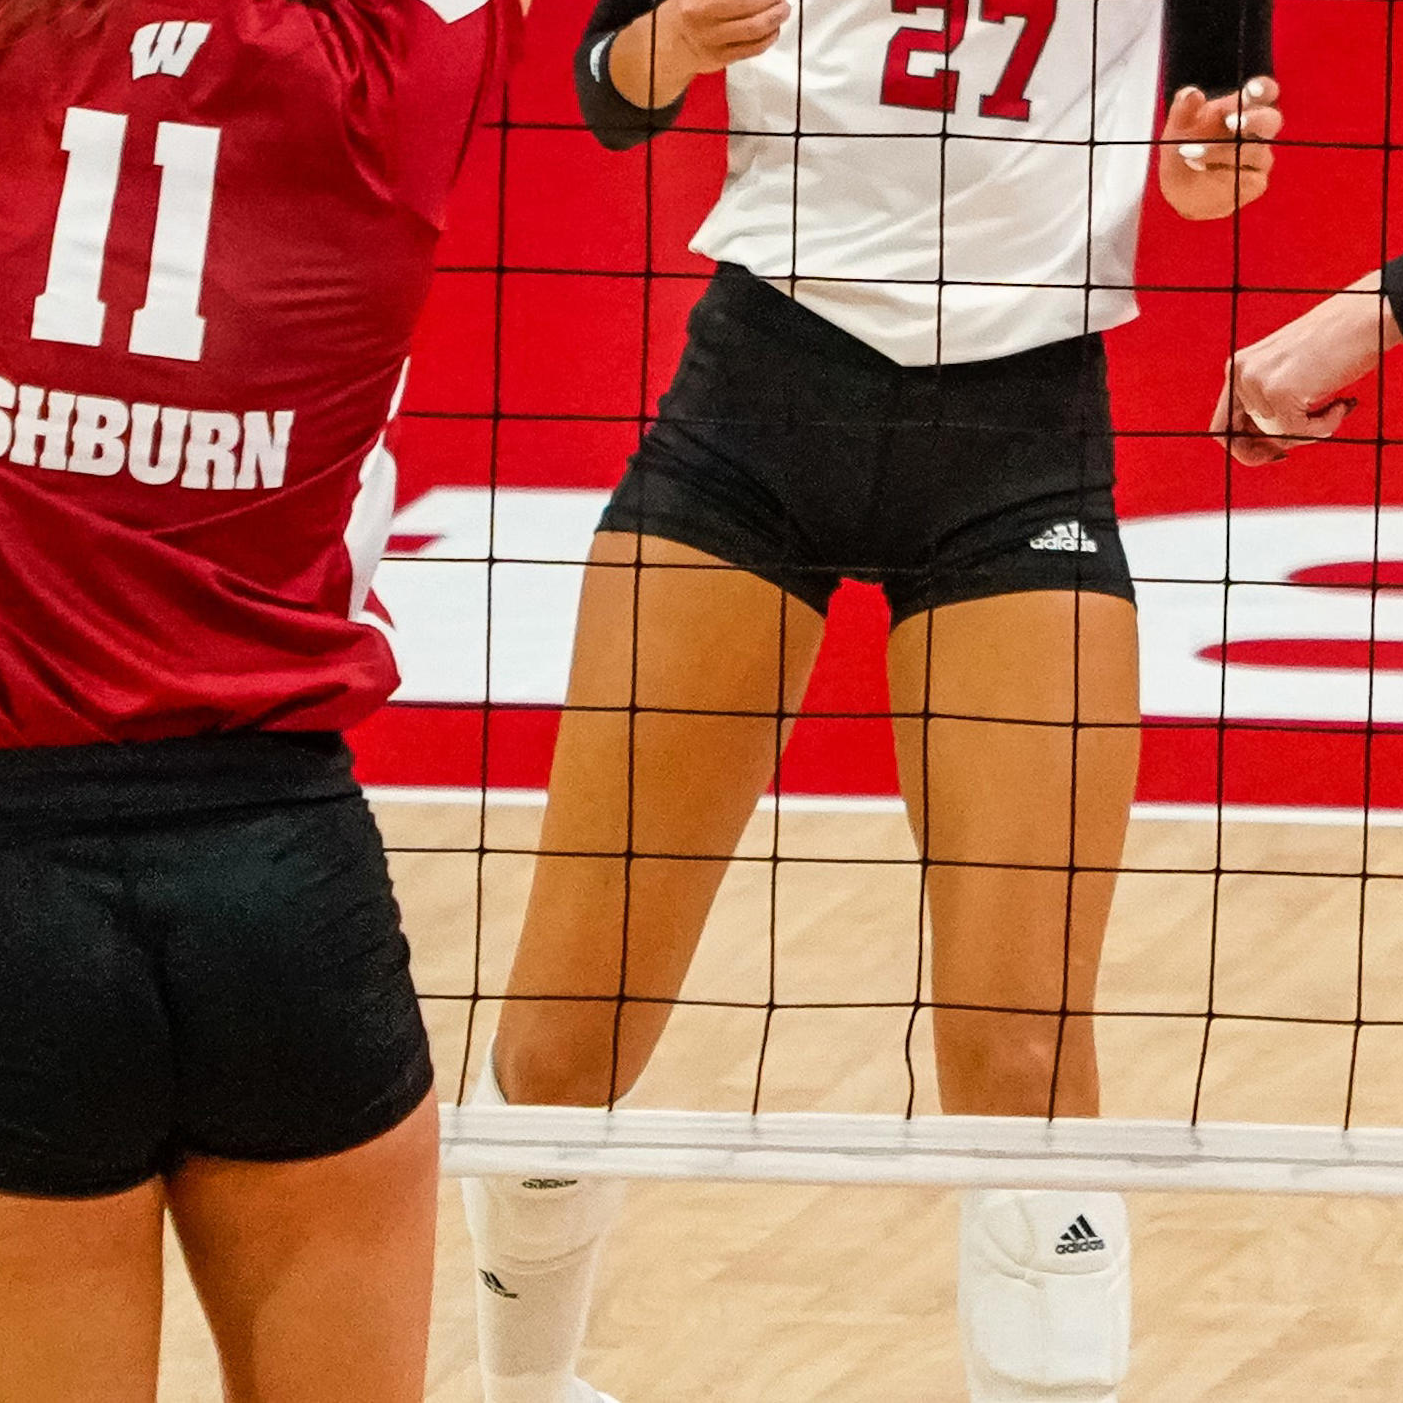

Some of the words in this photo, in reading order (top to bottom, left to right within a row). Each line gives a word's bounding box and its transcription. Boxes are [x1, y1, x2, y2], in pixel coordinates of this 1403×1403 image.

[129, 20, 213, 82] W
[30, 106, 222, 362] 11
[1054, 1239, 1106, 1255] adidas
